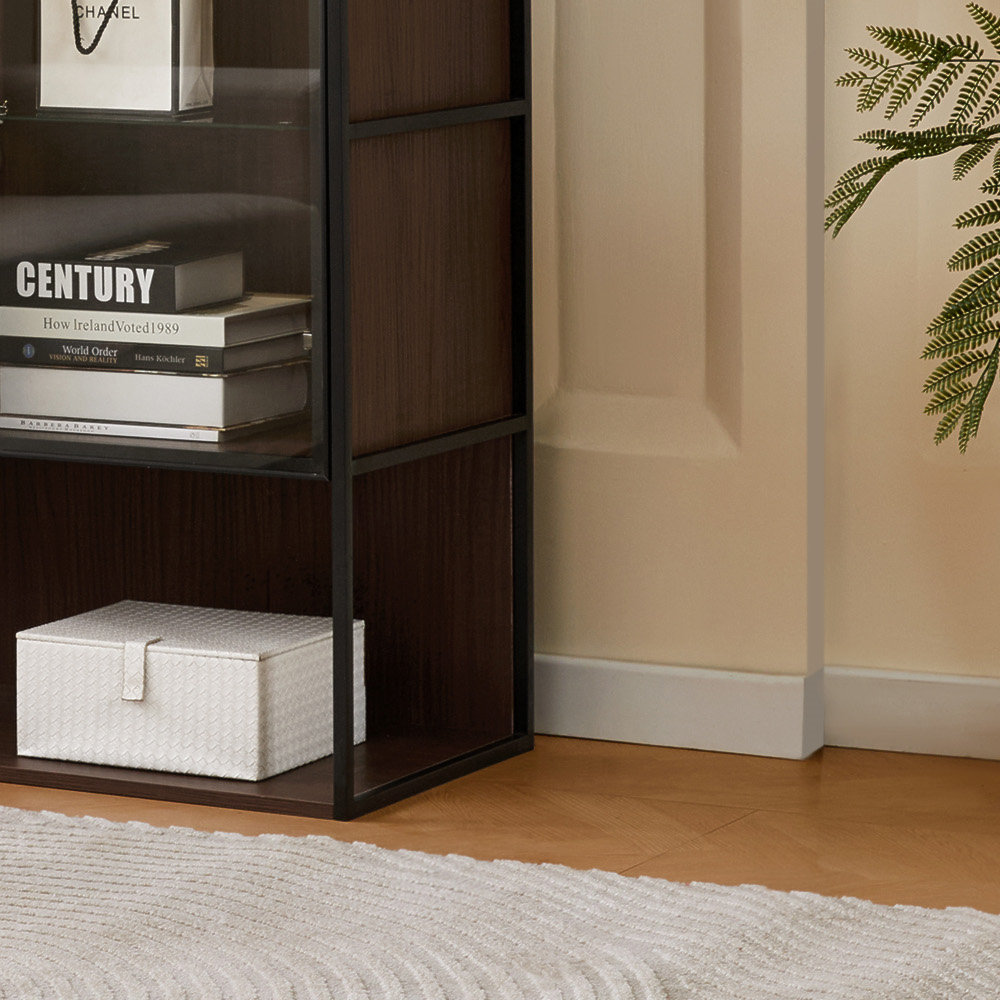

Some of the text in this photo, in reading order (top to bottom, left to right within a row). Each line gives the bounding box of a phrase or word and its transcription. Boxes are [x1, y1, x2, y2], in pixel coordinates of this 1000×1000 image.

[16, 261, 155, 304] CENTURY
[43, 317, 71, 330] How
[62, 344, 118, 357] World Order
[88, 356, 118, 364] REALITY
[135, 353, 154, 362] Hans
